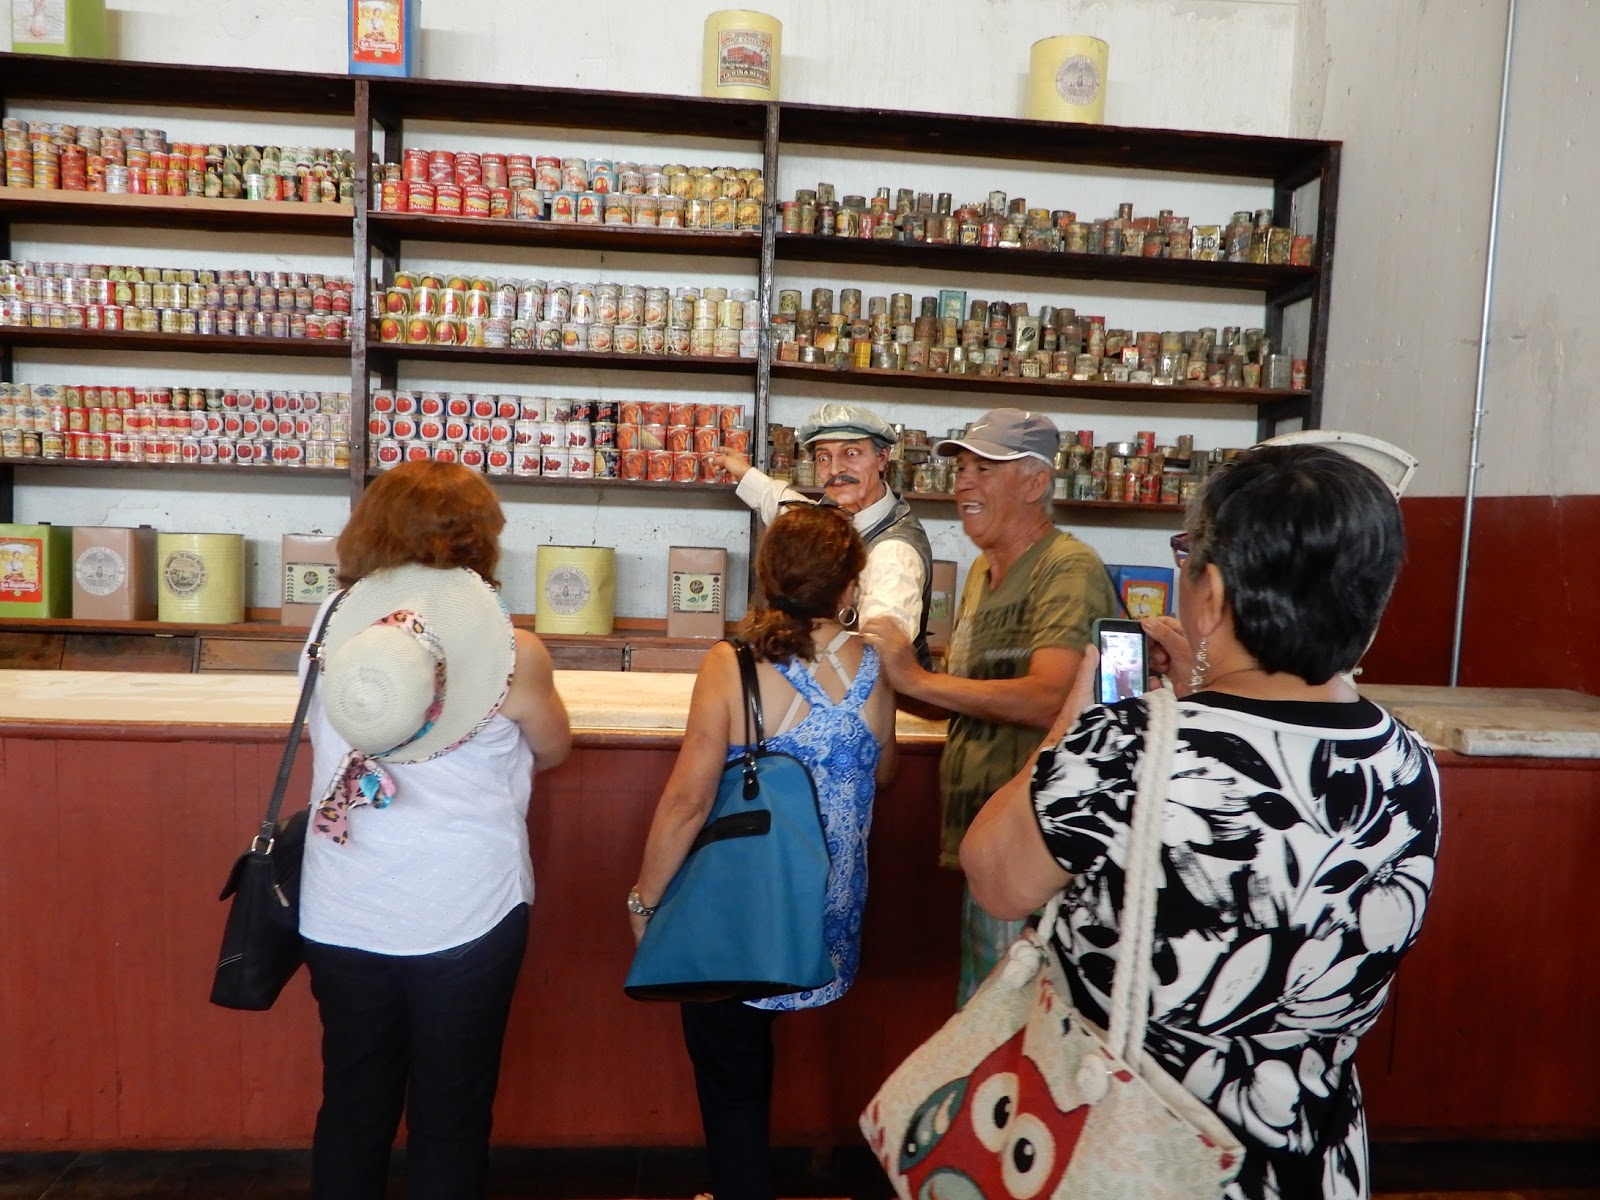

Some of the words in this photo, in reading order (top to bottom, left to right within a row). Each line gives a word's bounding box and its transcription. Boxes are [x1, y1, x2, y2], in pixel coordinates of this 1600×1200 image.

[409, 203, 433, 211] SALMON
[437, 204, 459, 212] SALMON
[466, 206, 489, 214] SALMON
